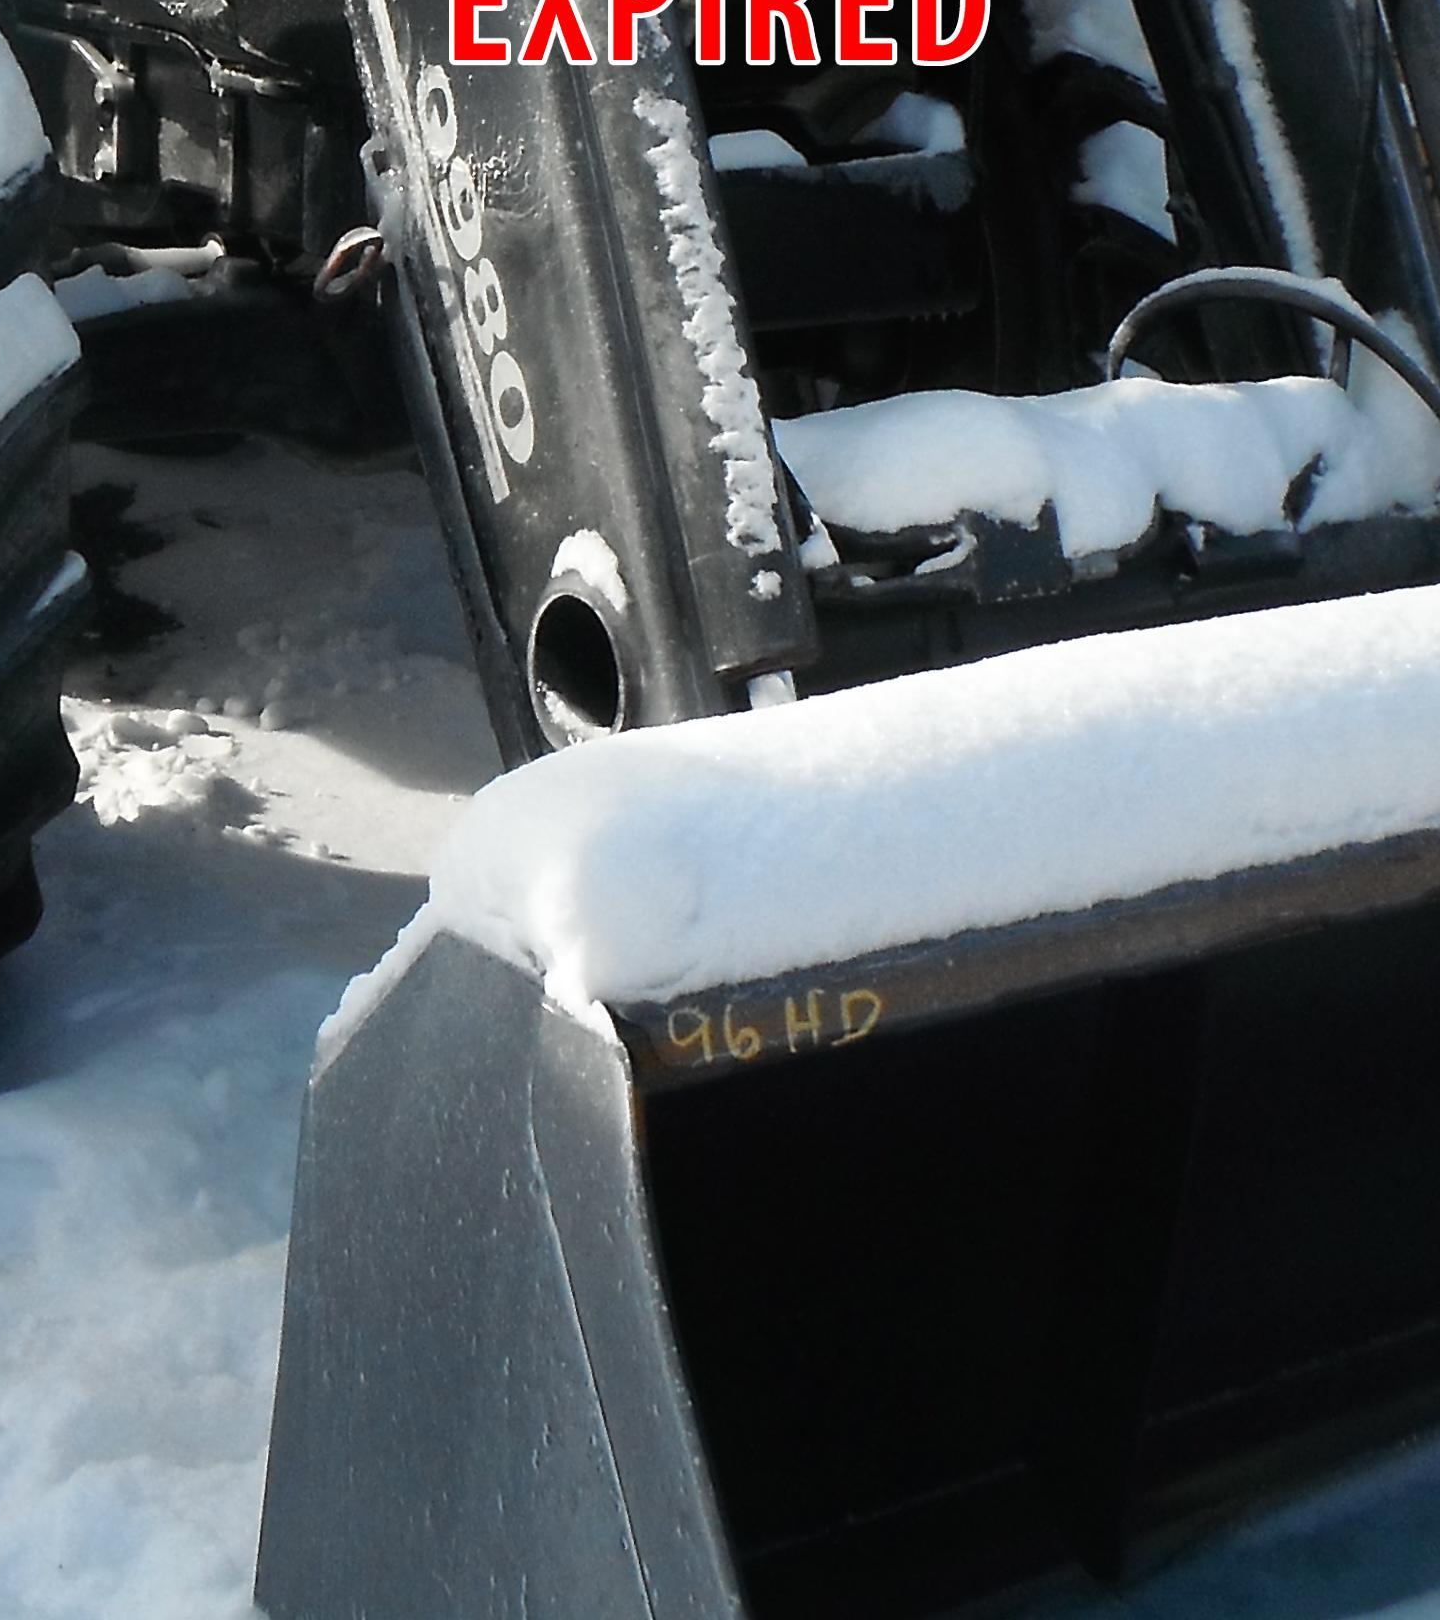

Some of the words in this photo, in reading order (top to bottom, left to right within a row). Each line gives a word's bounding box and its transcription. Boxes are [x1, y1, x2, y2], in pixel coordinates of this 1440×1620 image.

[415, 64, 535, 465] Q980
[667, 1005, 761, 1062] 96
[784, 988, 882, 1054] HD
